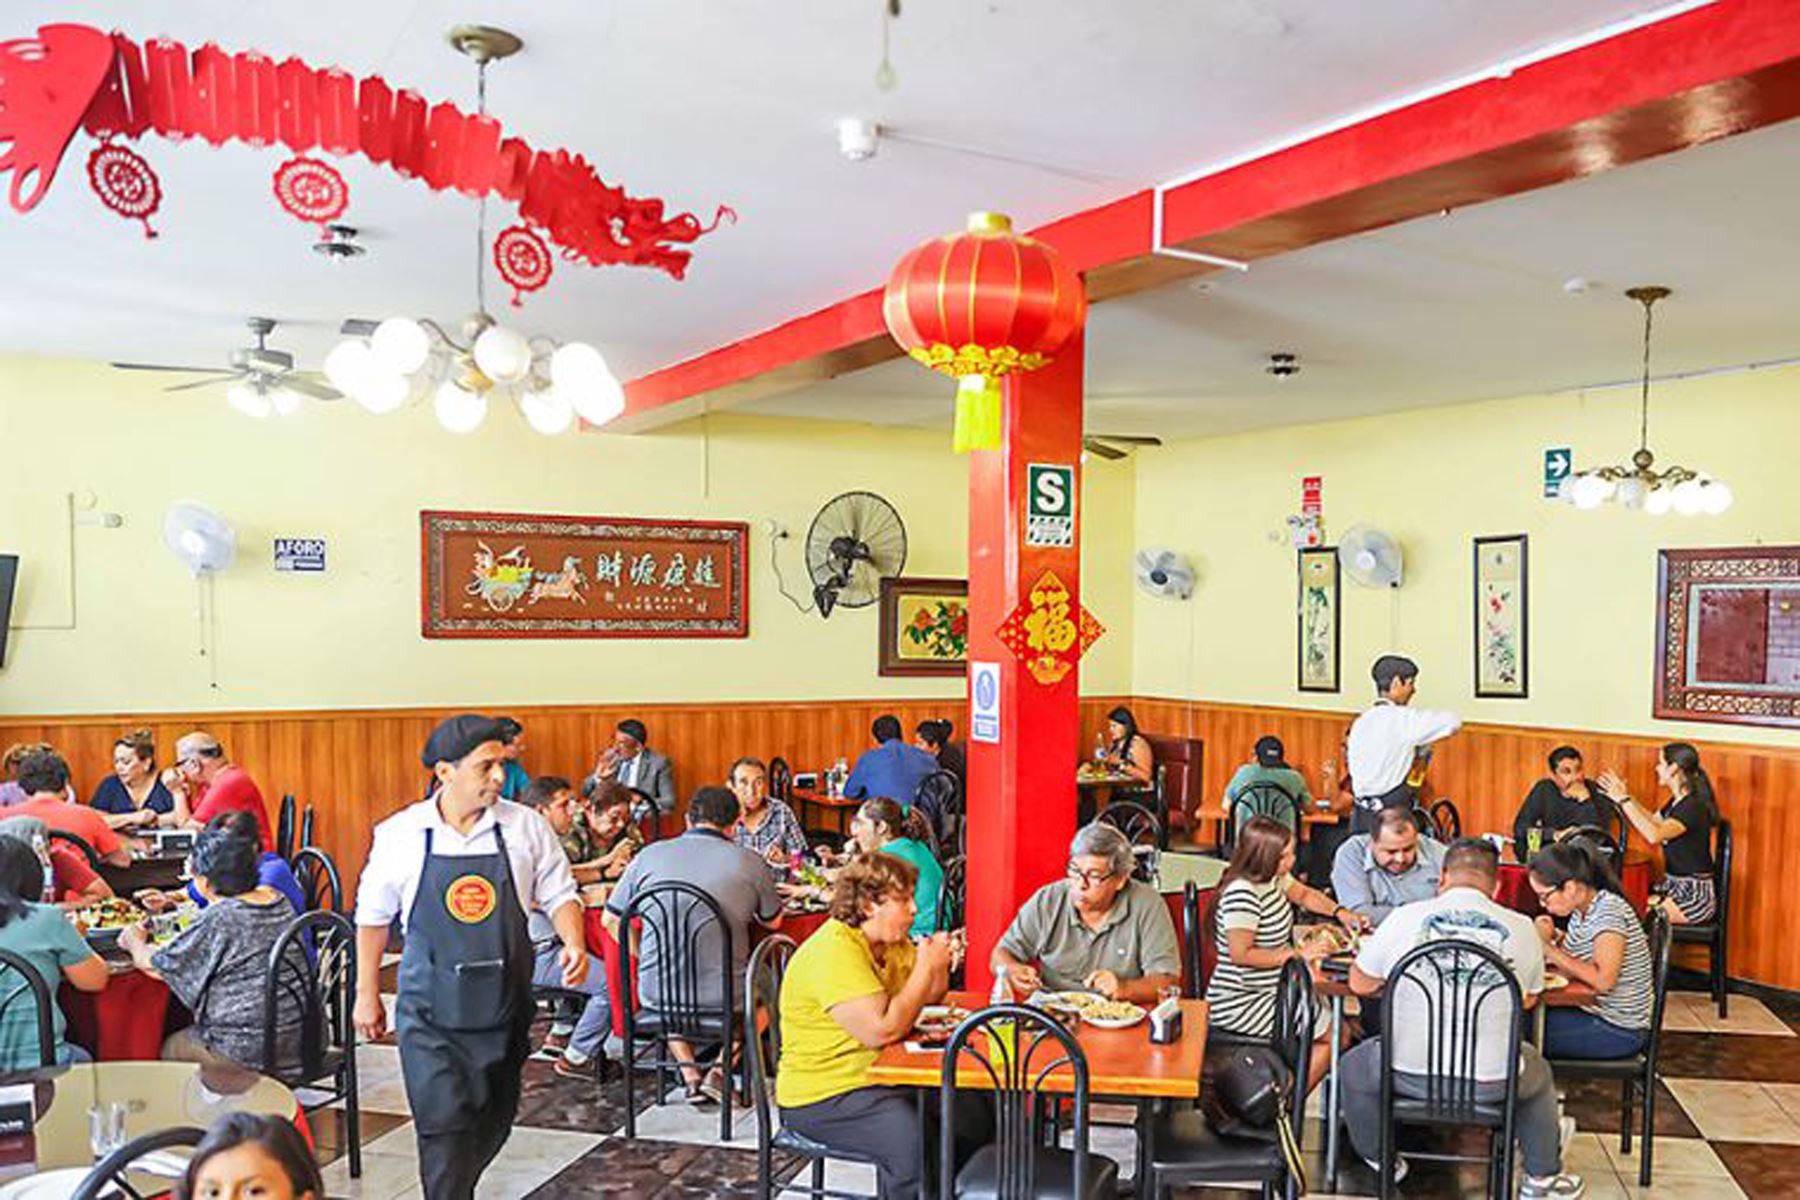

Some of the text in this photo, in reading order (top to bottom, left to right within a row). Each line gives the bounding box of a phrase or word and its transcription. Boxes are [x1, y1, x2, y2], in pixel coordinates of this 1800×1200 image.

[1036, 471, 1065, 512] S
[277, 541, 323, 555] AFORO
[1024, 590, 1076, 651] 福
